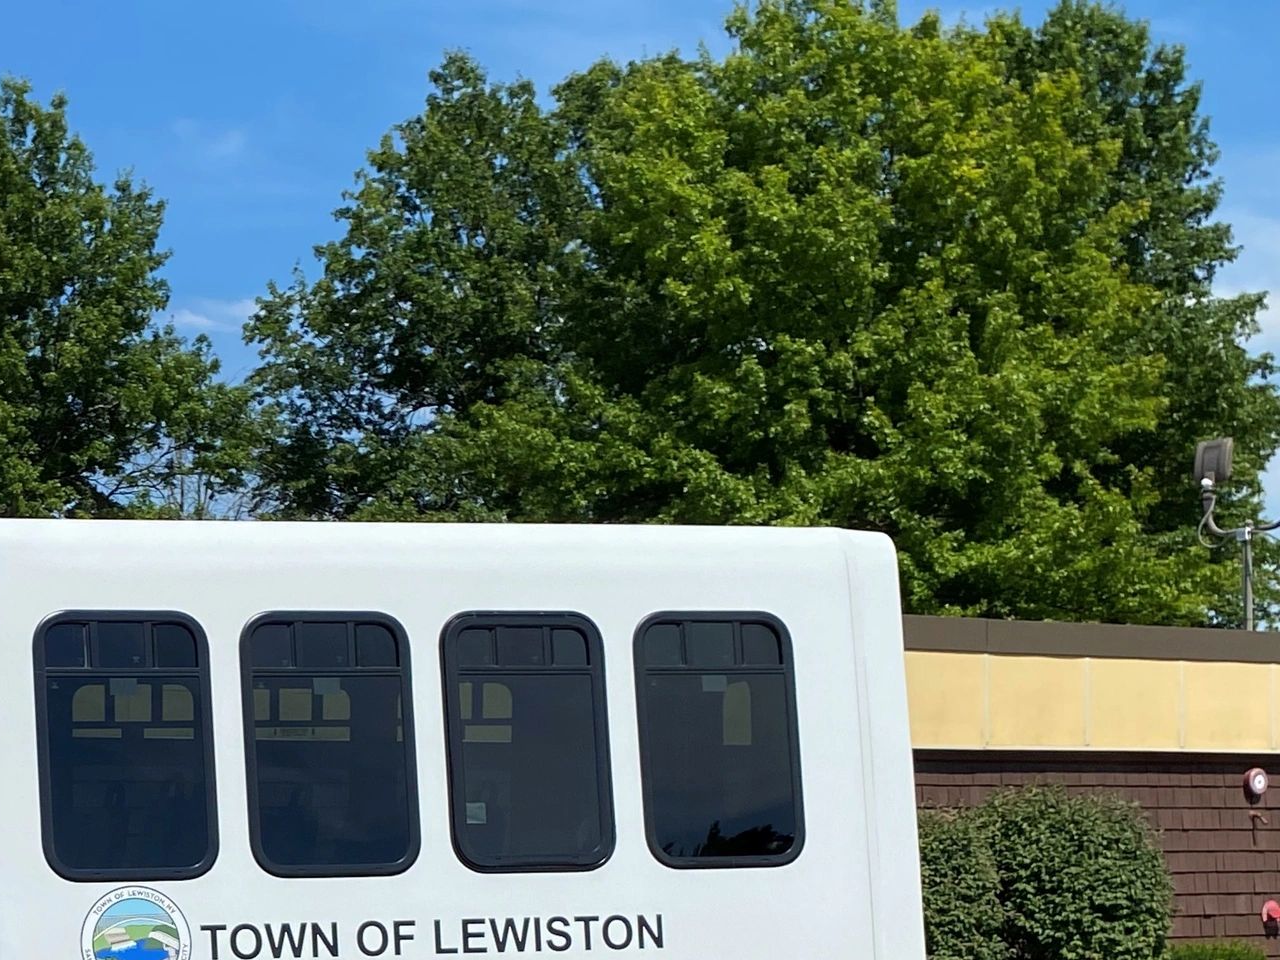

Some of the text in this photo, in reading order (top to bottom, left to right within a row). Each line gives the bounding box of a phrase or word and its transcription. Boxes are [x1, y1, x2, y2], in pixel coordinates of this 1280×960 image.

[92, 897, 113, 916] TOWN
[114, 891, 125, 900] OF
[200, 914, 665, 960] TOWN OF LEWISTON
